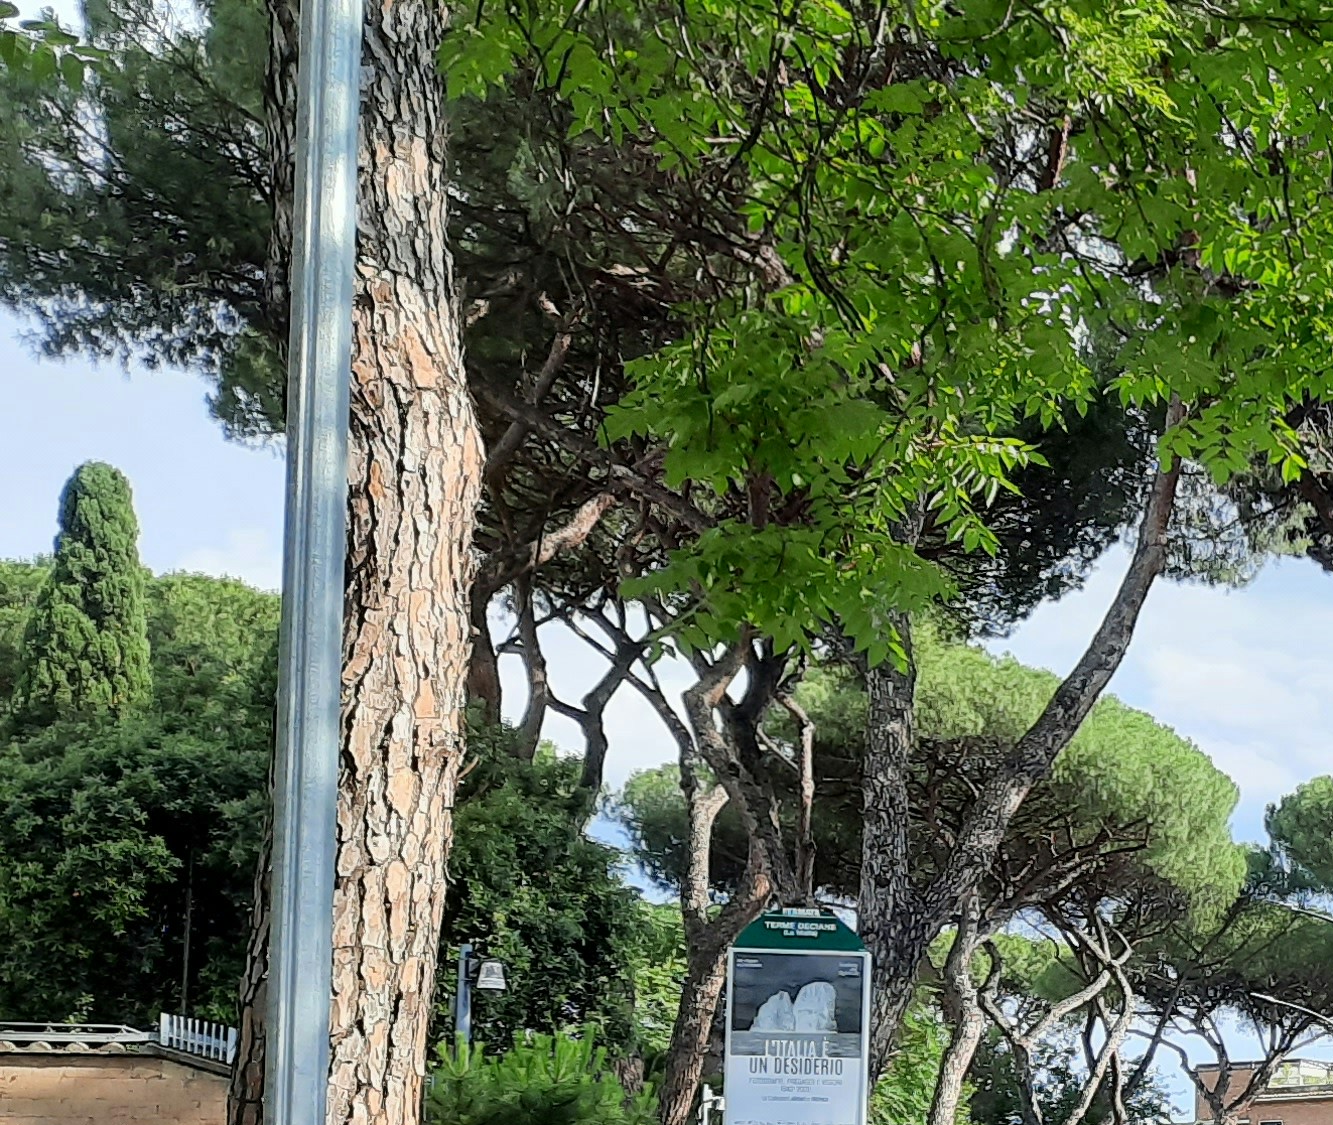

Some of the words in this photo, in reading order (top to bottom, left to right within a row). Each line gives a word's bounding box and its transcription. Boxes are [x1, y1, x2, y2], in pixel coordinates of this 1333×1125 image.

[764, 921, 796, 929] TERME
[764, 1039, 817, 1057] L'ITALIA
[822, 1036, 830, 1057] È
[749, 1057, 768, 1074] UN
[774, 1057, 843, 1075] DESIDERIO
